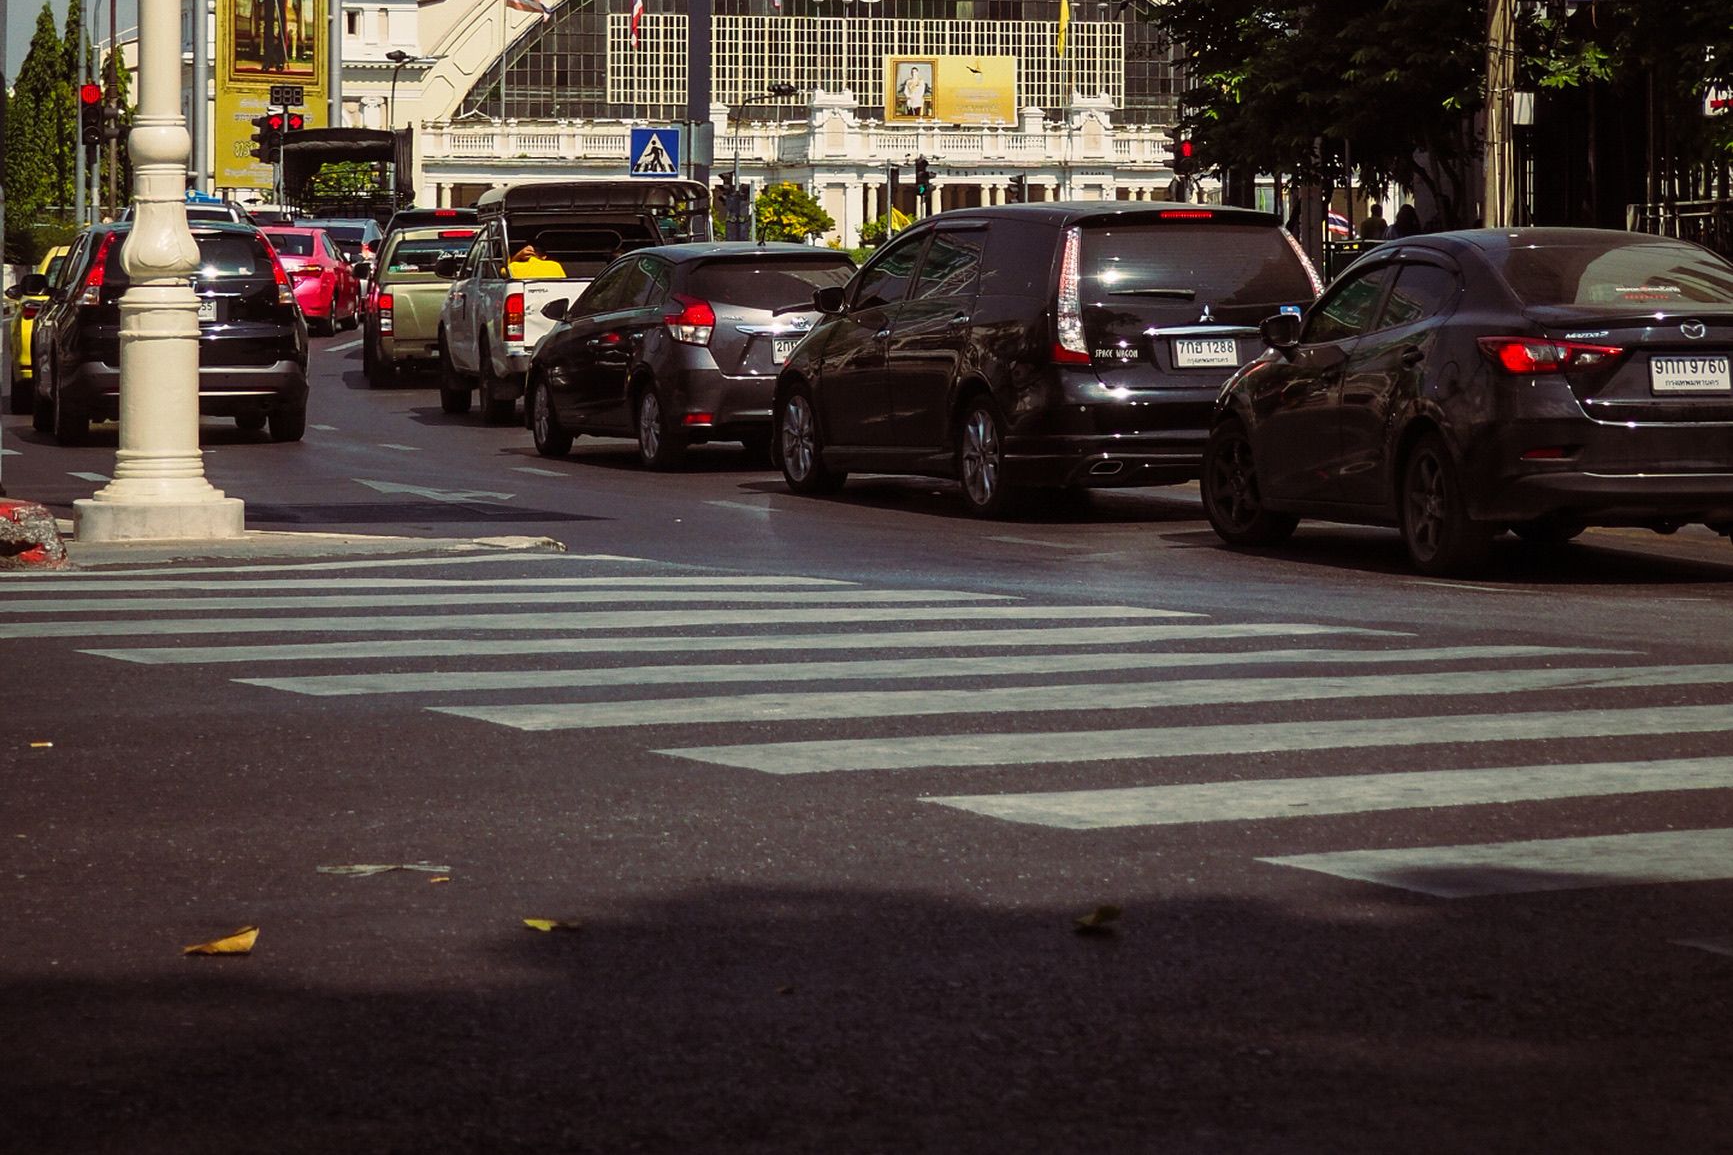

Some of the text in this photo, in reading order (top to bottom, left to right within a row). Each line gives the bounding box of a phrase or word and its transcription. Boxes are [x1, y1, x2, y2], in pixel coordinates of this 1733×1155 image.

[1207, 340, 1234, 353] 1288
[1095, 349, 1139, 358] SPACE WAGON
[1655, 358, 1726, 374] 9กก 9760
